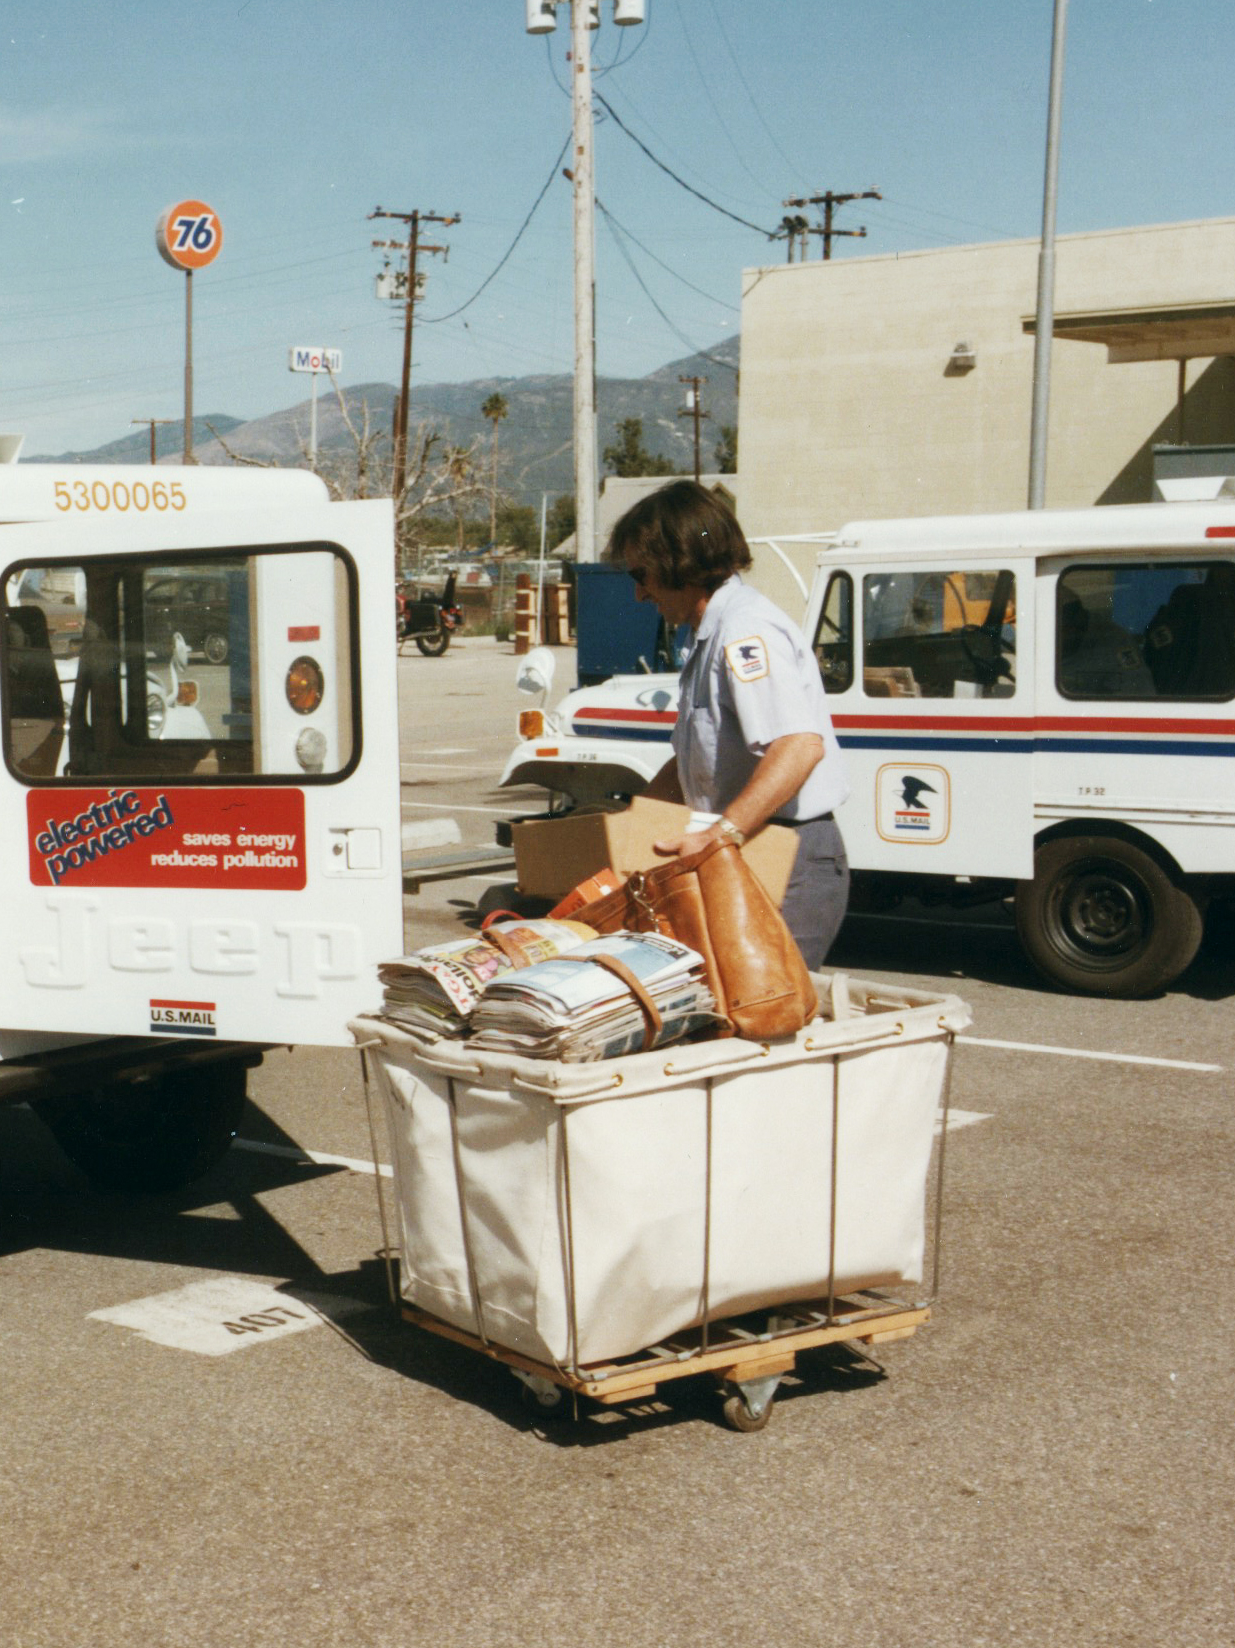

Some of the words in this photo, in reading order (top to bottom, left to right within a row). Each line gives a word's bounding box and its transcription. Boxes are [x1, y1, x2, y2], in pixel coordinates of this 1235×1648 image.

[174, 215, 214, 252] 76
[296, 350, 340, 370] Mobil
[53, 480, 187, 512] 5300065
[35, 789, 142, 855] electric
[45, 794, 175, 886] powered
[182, 832, 231, 847] saves
[236, 833, 296, 850] energy
[151, 850, 218, 867] reduces
[223, 851, 298, 870] pollution
[18, 890, 361, 1000] Jeep
[222, 1306, 306, 1335] 407
